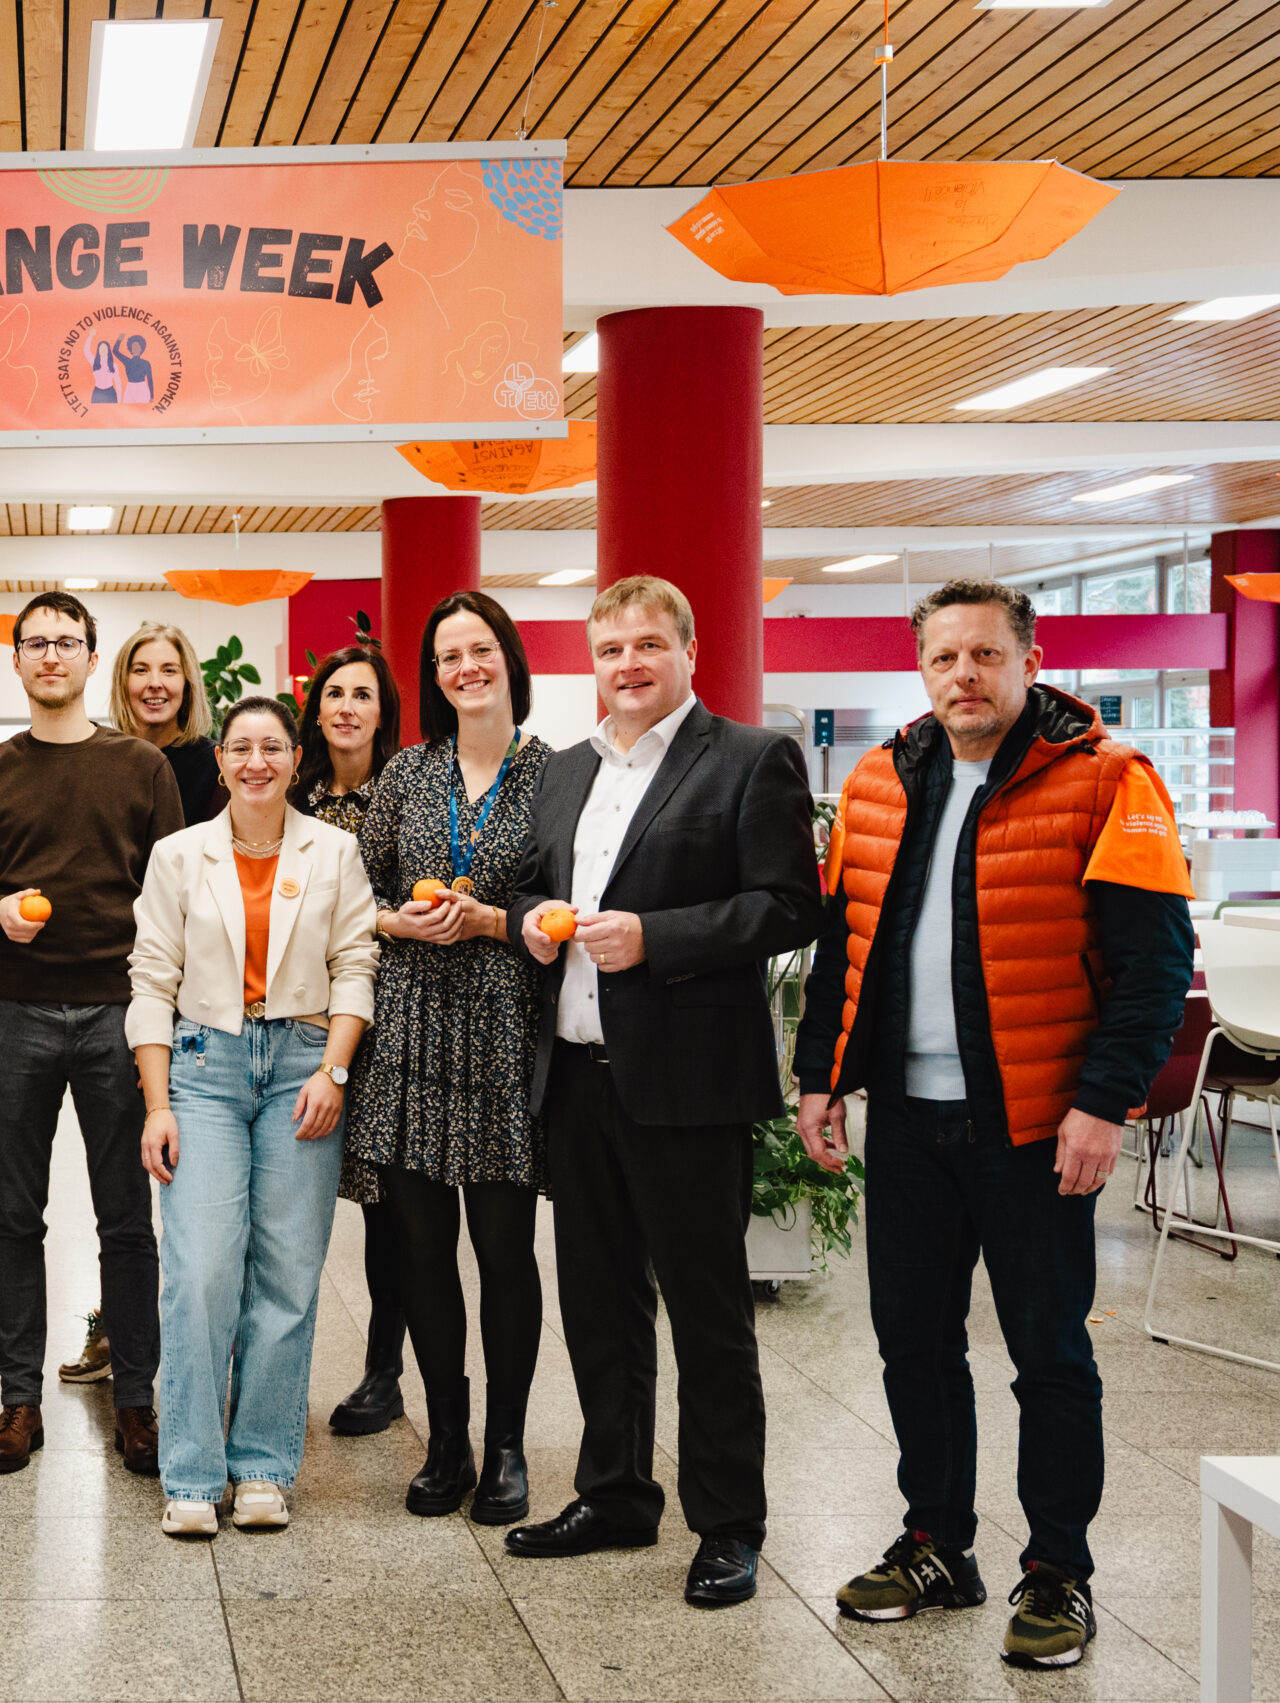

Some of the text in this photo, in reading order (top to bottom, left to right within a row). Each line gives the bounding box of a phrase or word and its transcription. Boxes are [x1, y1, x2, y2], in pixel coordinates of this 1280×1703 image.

[183, 223, 394, 309] WEEK
[58, 306, 183, 418] LTETT SAYS NO TO VIOLENCE AGAINST WOMEN.
[472, 440, 535, 464] AGAINST
